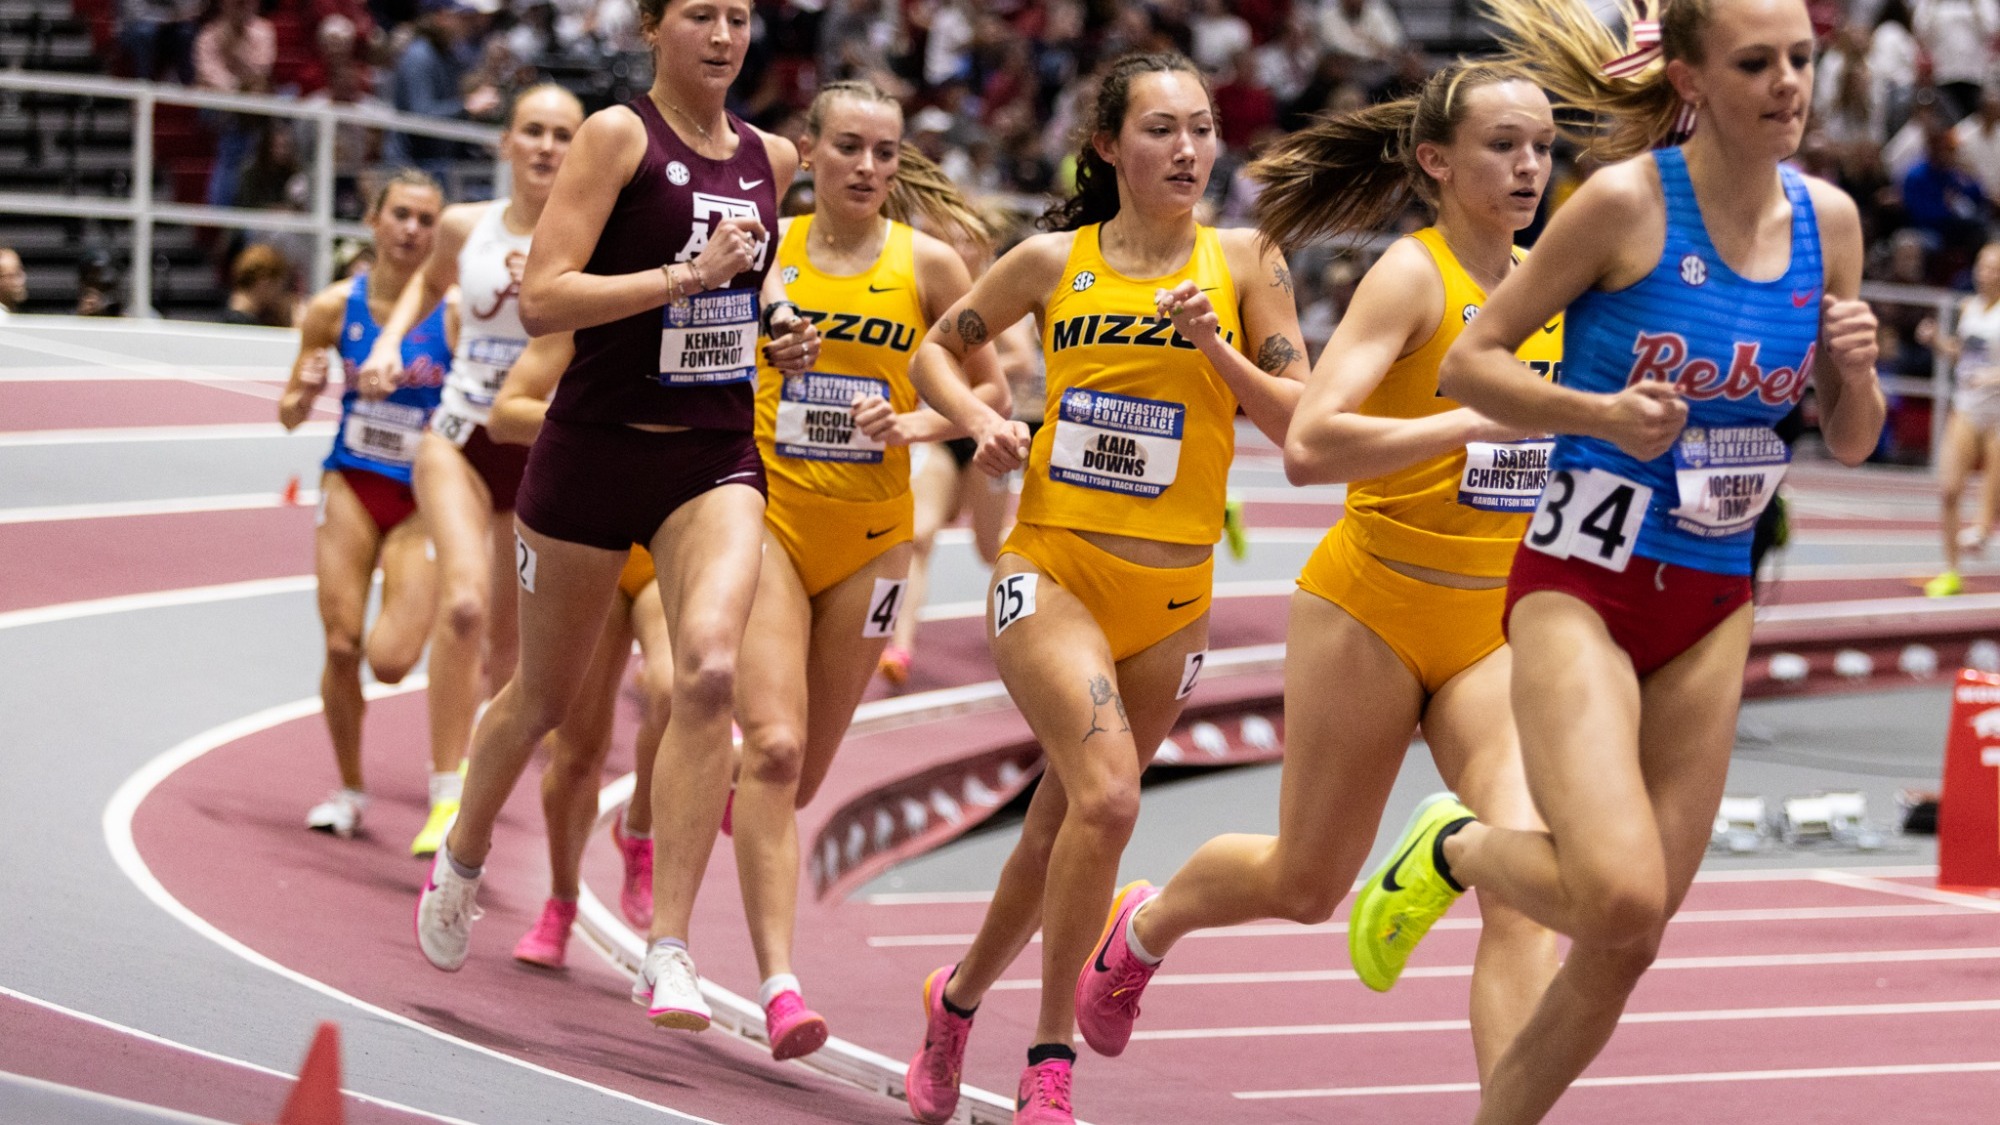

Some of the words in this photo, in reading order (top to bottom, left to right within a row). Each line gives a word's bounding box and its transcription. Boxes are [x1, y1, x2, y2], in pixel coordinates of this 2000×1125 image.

[1072, 271, 1095, 292] SEC
[1681, 255, 1706, 285] SEC
[692, 304, 754, 320] CONFERENCE
[685, 329, 743, 350] KENNADY
[799, 309, 915, 352] ZZOU
[1054, 314, 1233, 352] MIZZ
[680, 347, 744, 368] FONTENOT
[1093, 408, 1174, 430] CONFERENCE
[1095, 396, 1175, 419] SOUTHEASTERN
[808, 426, 852, 444] LOUW
[1097, 433, 1137, 457] KAIA
[1082, 450, 1146, 477] DOWNS
[1492, 449, 1547, 469] ISABELLE
[1062, 470, 1088, 483] RANDAL
[1089, 475, 1111, 487] TYSON
[1112, 479, 1134, 491] TRACK
[1135, 484, 1160, 495] CENTER
[1709, 473, 1765, 498] JOCELYN
[1472, 495, 1499, 506] RANDAL
[1500, 497, 1520, 507] TYSON
[1530, 471, 1636, 560] 34
[871, 584, 901, 633] 4
[996, 575, 1024, 630] 25
